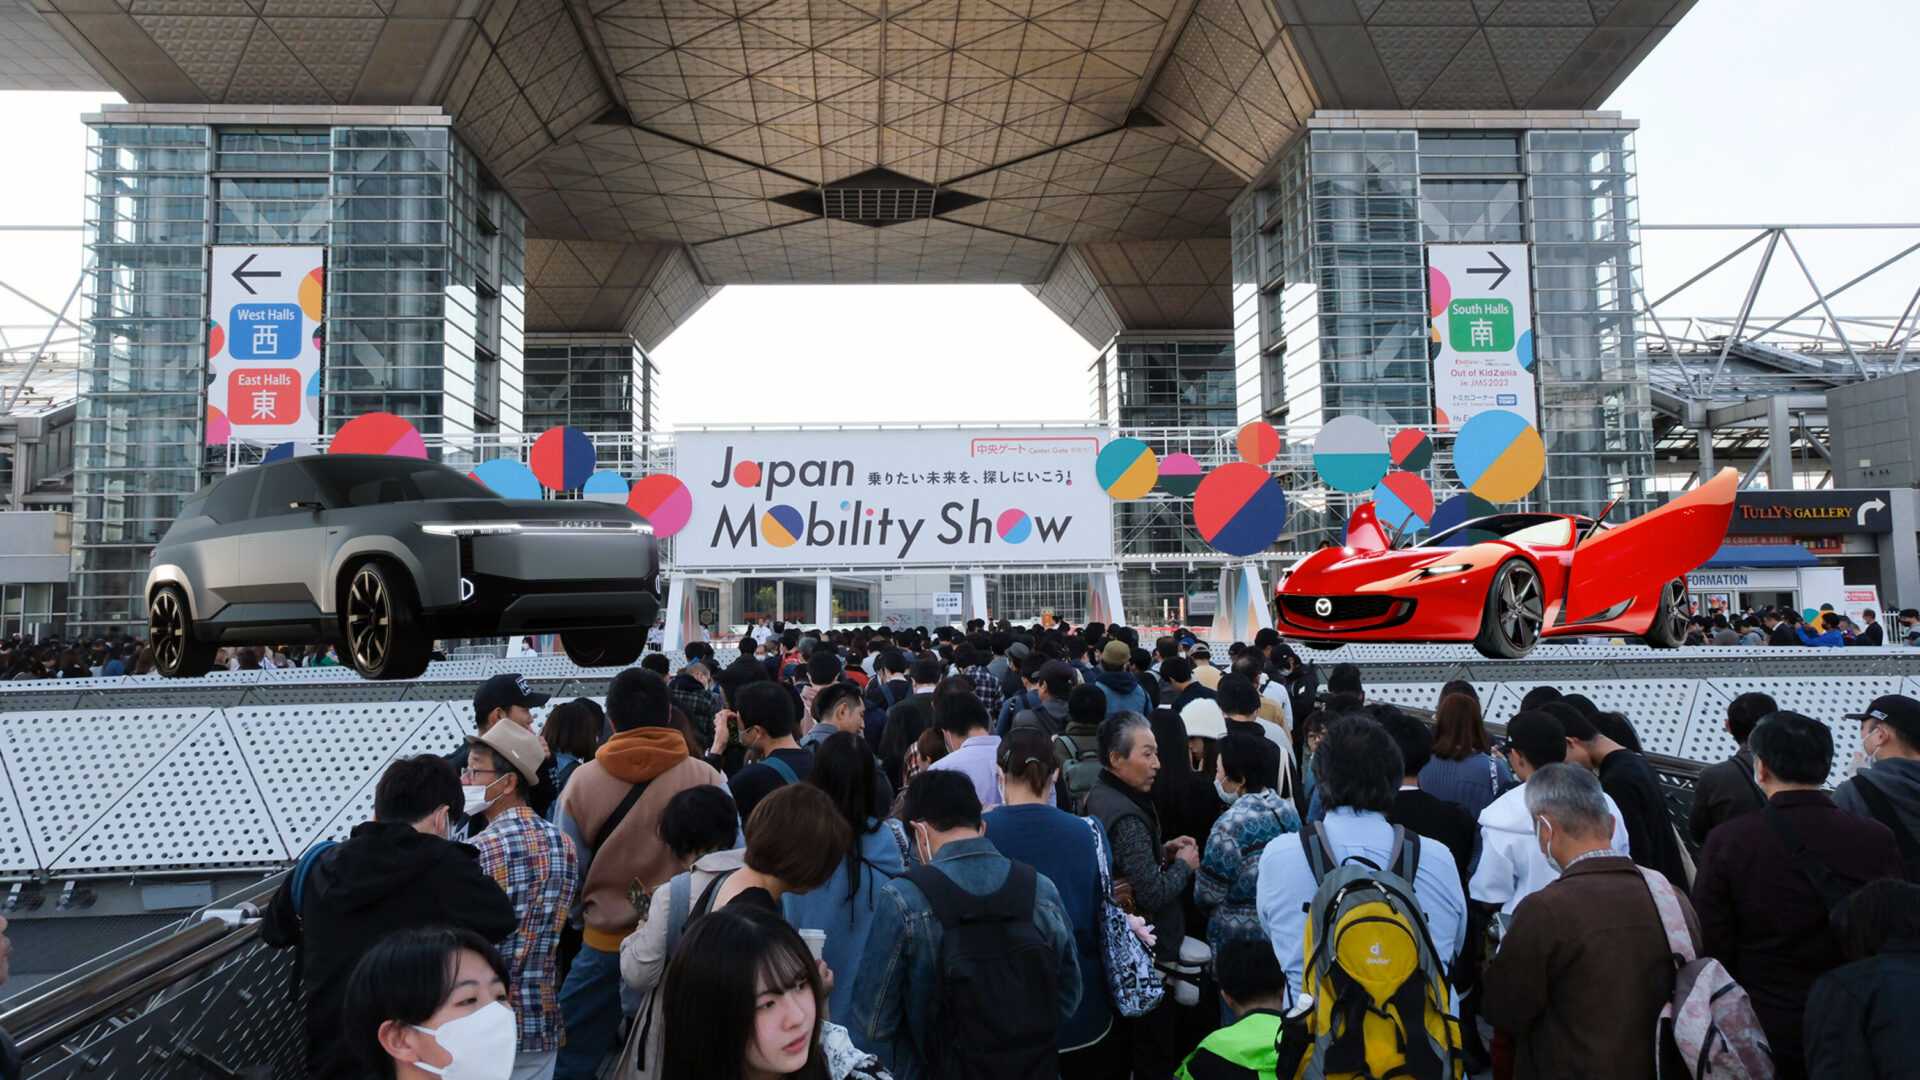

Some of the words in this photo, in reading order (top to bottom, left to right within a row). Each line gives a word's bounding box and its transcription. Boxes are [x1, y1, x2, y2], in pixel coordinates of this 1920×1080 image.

[237, 308, 266, 321] West
[267, 308, 295, 321] Halls
[1452, 303, 1483, 315] South
[1484, 303, 1509, 315] Halls
[1470, 318, 1493, 347] 南
[252, 324, 279, 355] 西
[1450, 369, 1466, 377] Out
[1468, 369, 1477, 377] of
[1479, 369, 1518, 377] KidZania
[238, 374, 262, 386] East
[263, 374, 291, 386] Halls
[1460, 379, 1468, 387] in
[1471, 379, 1509, 387] JMS2023
[251, 389, 278, 420] 東
[976, 443, 1026, 455] 中央ゲート
[1051, 446, 1068, 454] Gate
[710, 446, 855, 501] Japan
[1793, 507, 1853, 519] GALLERY
[559, 520, 602, 528] TOYOTA
[710, 499, 926, 559] Mobility
[936, 497, 1073, 545] Show
[1732, 536, 1758, 544] COURT
[1686, 574, 1748, 586] FORMATION
